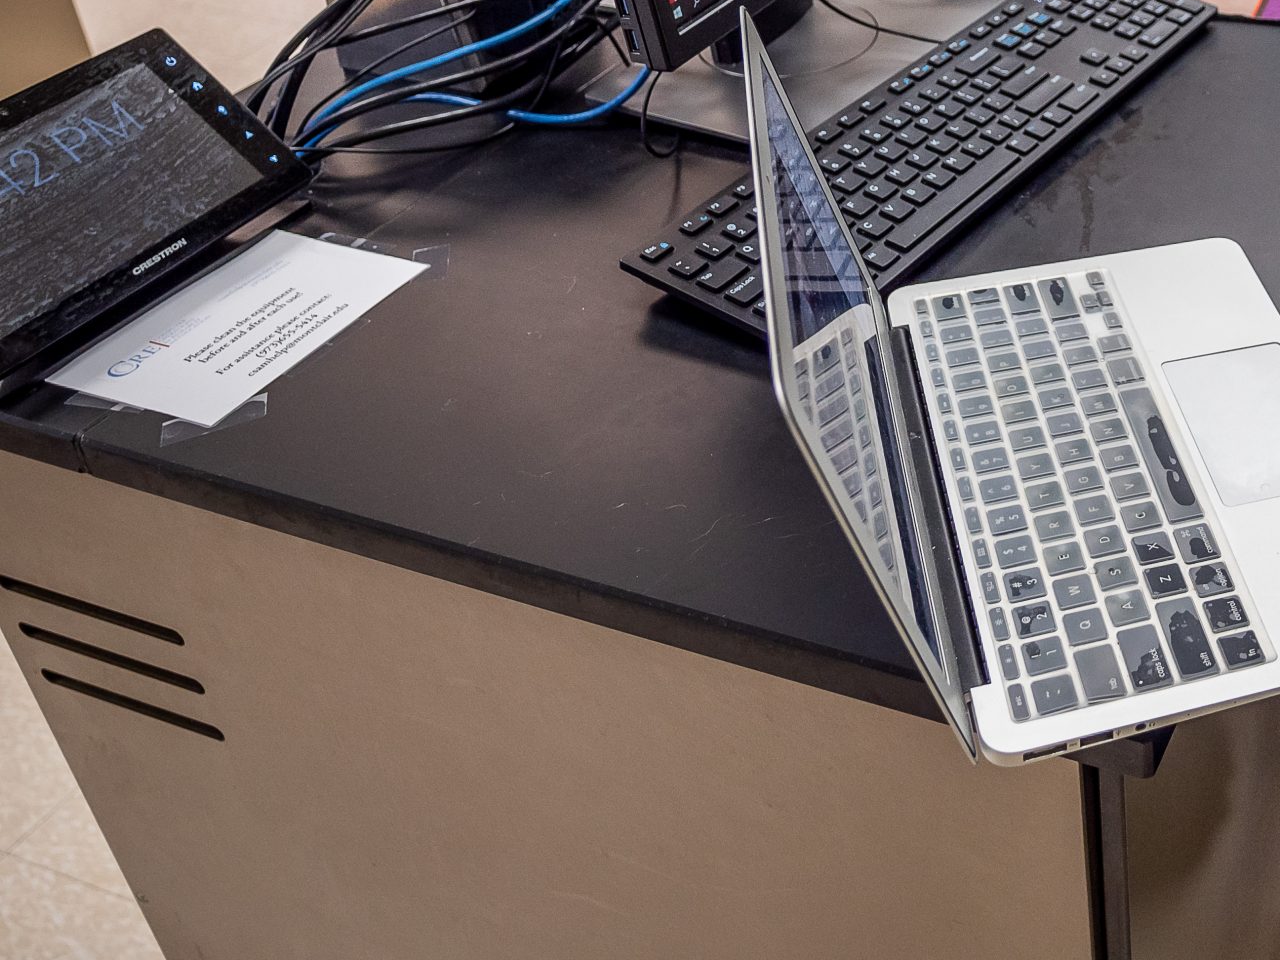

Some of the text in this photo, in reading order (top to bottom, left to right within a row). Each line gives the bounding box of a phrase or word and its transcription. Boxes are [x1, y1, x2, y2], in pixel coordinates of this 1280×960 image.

[51, 99, 146, 164] PM
[132, 237, 188, 276] CRESTRON
[644, 245, 657, 254] Esc
[742, 245, 754, 253] Q
[700, 272, 713, 281] Tab
[729, 275, 756, 295] Caps Lock
[184, 342, 213, 363] Please
[213, 326, 236, 343] clean
[235, 316, 251, 329] the
[251, 286, 296, 317] equipment
[198, 342, 230, 364] before
[230, 330, 247, 344] and
[247, 315, 267, 331] after
[267, 302, 287, 317] each
[215, 361, 234, 375] For
[234, 332, 275, 364] assistance
[274, 314, 299, 335] please
[1195, 525, 1215, 554] command
[1214, 567, 1229, 588] option
[1226, 599, 1243, 622] control
[1199, 650, 1213, 669] shift
[1247, 647, 1258, 659] fn
